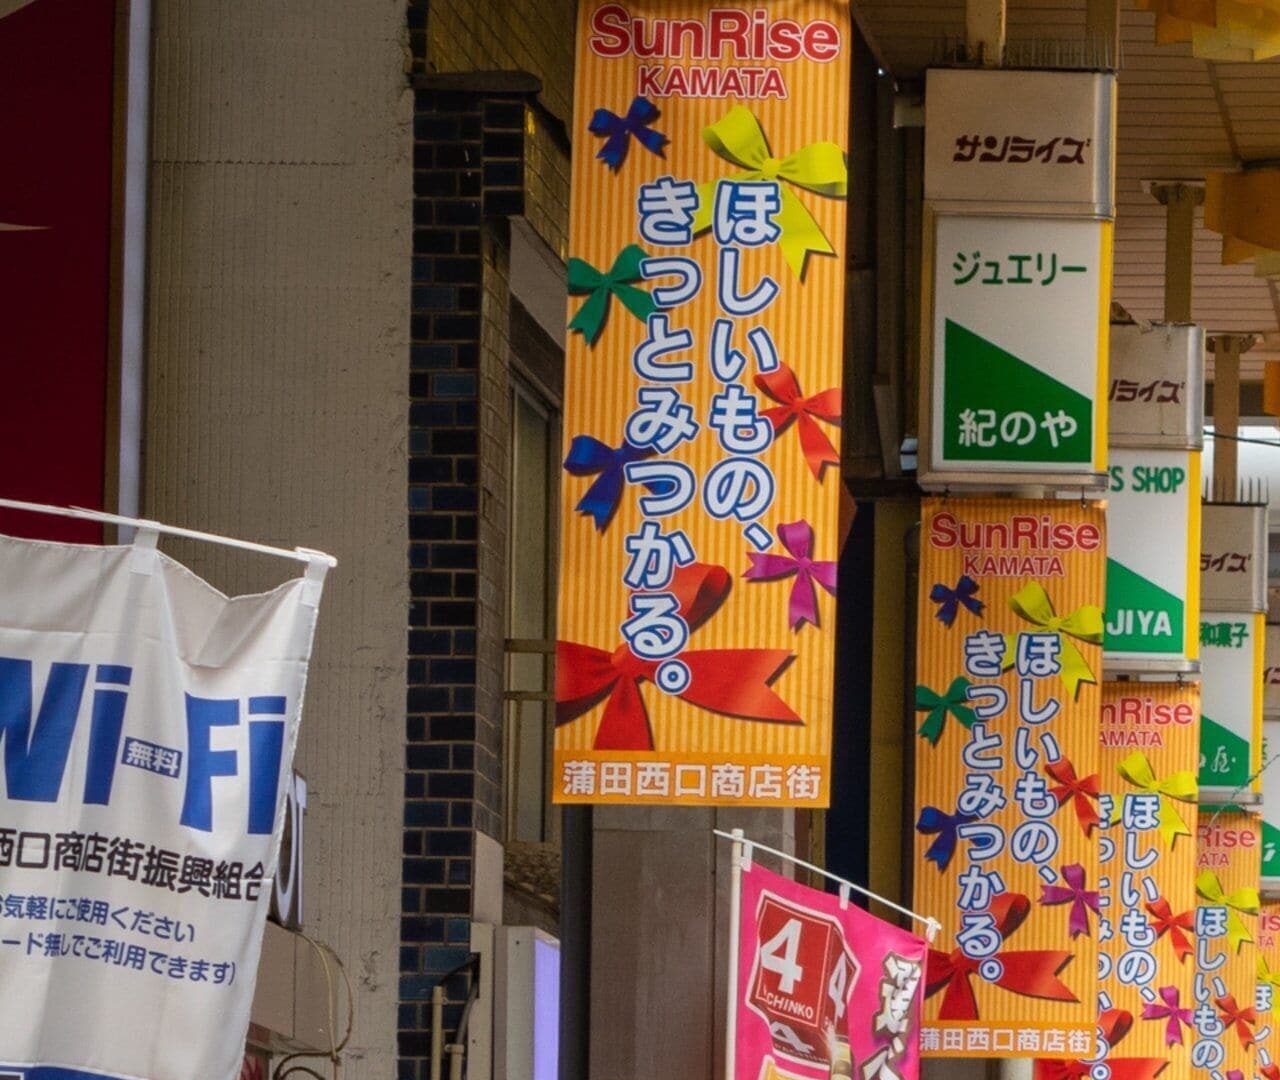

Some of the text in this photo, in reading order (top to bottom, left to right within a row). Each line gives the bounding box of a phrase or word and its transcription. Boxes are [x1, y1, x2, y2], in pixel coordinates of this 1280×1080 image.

[588, 8, 841, 61] SunRise
[636, 66, 788, 100] KAMATA
[952, 134, 1091, 166] サンライズ
[952, 250, 1088, 287] ジュエリー
[702, 178, 782, 553] ほしいもの、
[619, 176, 702, 697] きっとみつかる。
[957, 408, 1078, 448] 紀のや
[1132, 465, 1186, 494] SHOP
[930, 512, 1101, 551] SunRise
[964, 555, 1065, 577] KAMATA
[1009, 632, 1063, 885] ほしいもの、
[562, 758, 822, 802] 蒲田西口商店街
[956, 631, 1007, 982] きっとみつかる。
[1116, 793, 1162, 1004] ほしいもの、
[759, 917, 804, 995] 4
[919, 1027, 1092, 1055] 蒲田西口商店街
